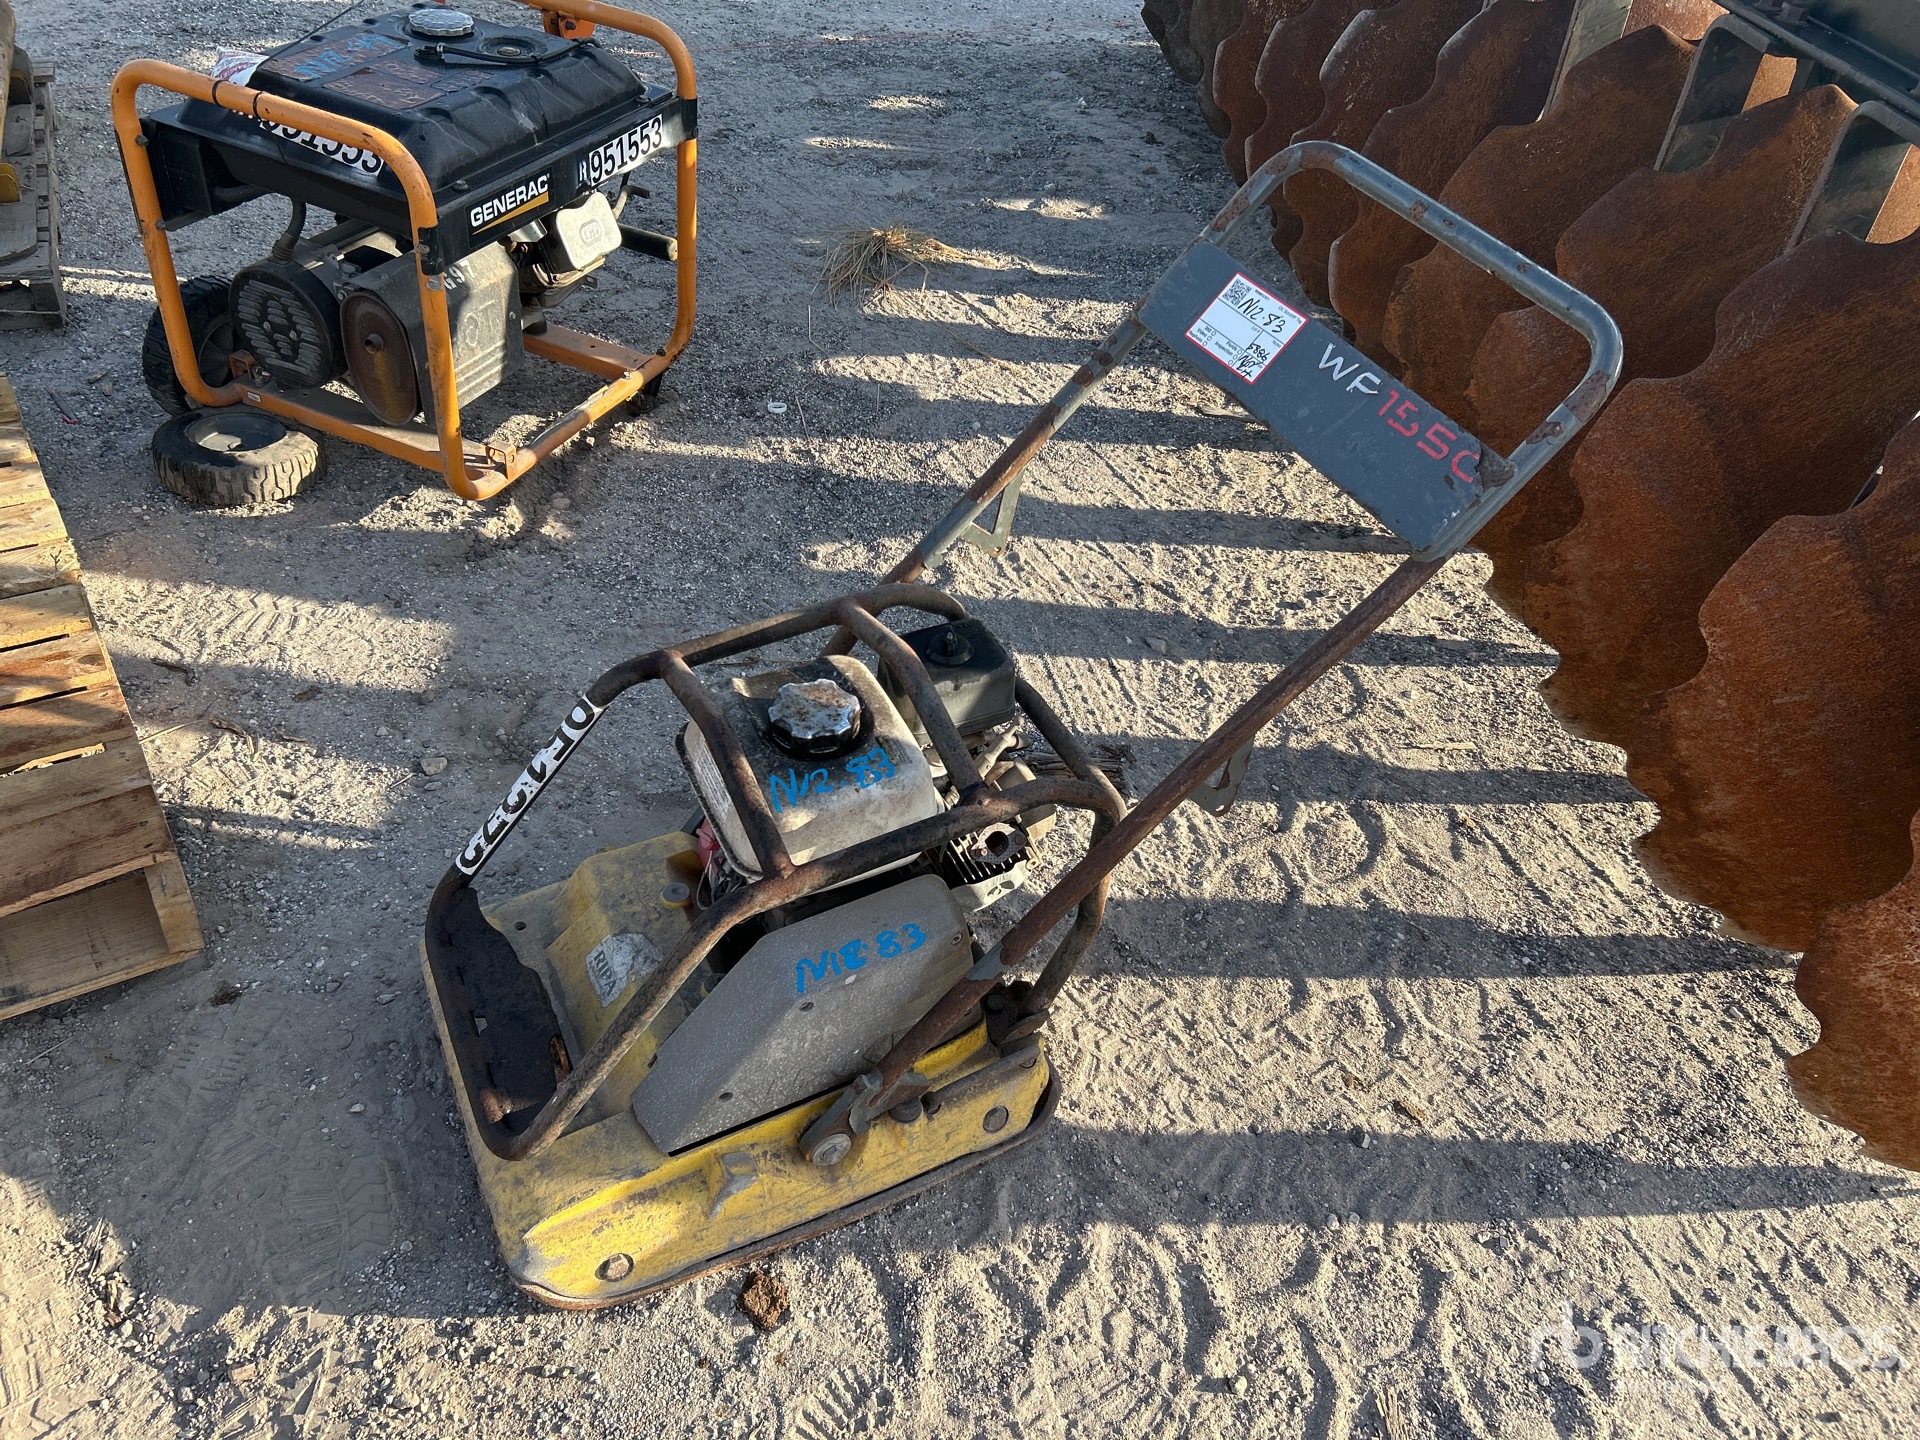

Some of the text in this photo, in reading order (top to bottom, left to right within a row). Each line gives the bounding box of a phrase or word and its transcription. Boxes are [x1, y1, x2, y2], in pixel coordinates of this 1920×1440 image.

[590, 117, 662, 183] 951553
[470, 175, 549, 227] GENERAC
[1213, 340, 1234, 357] Inspection
[593, 949, 617, 998] RIPA
